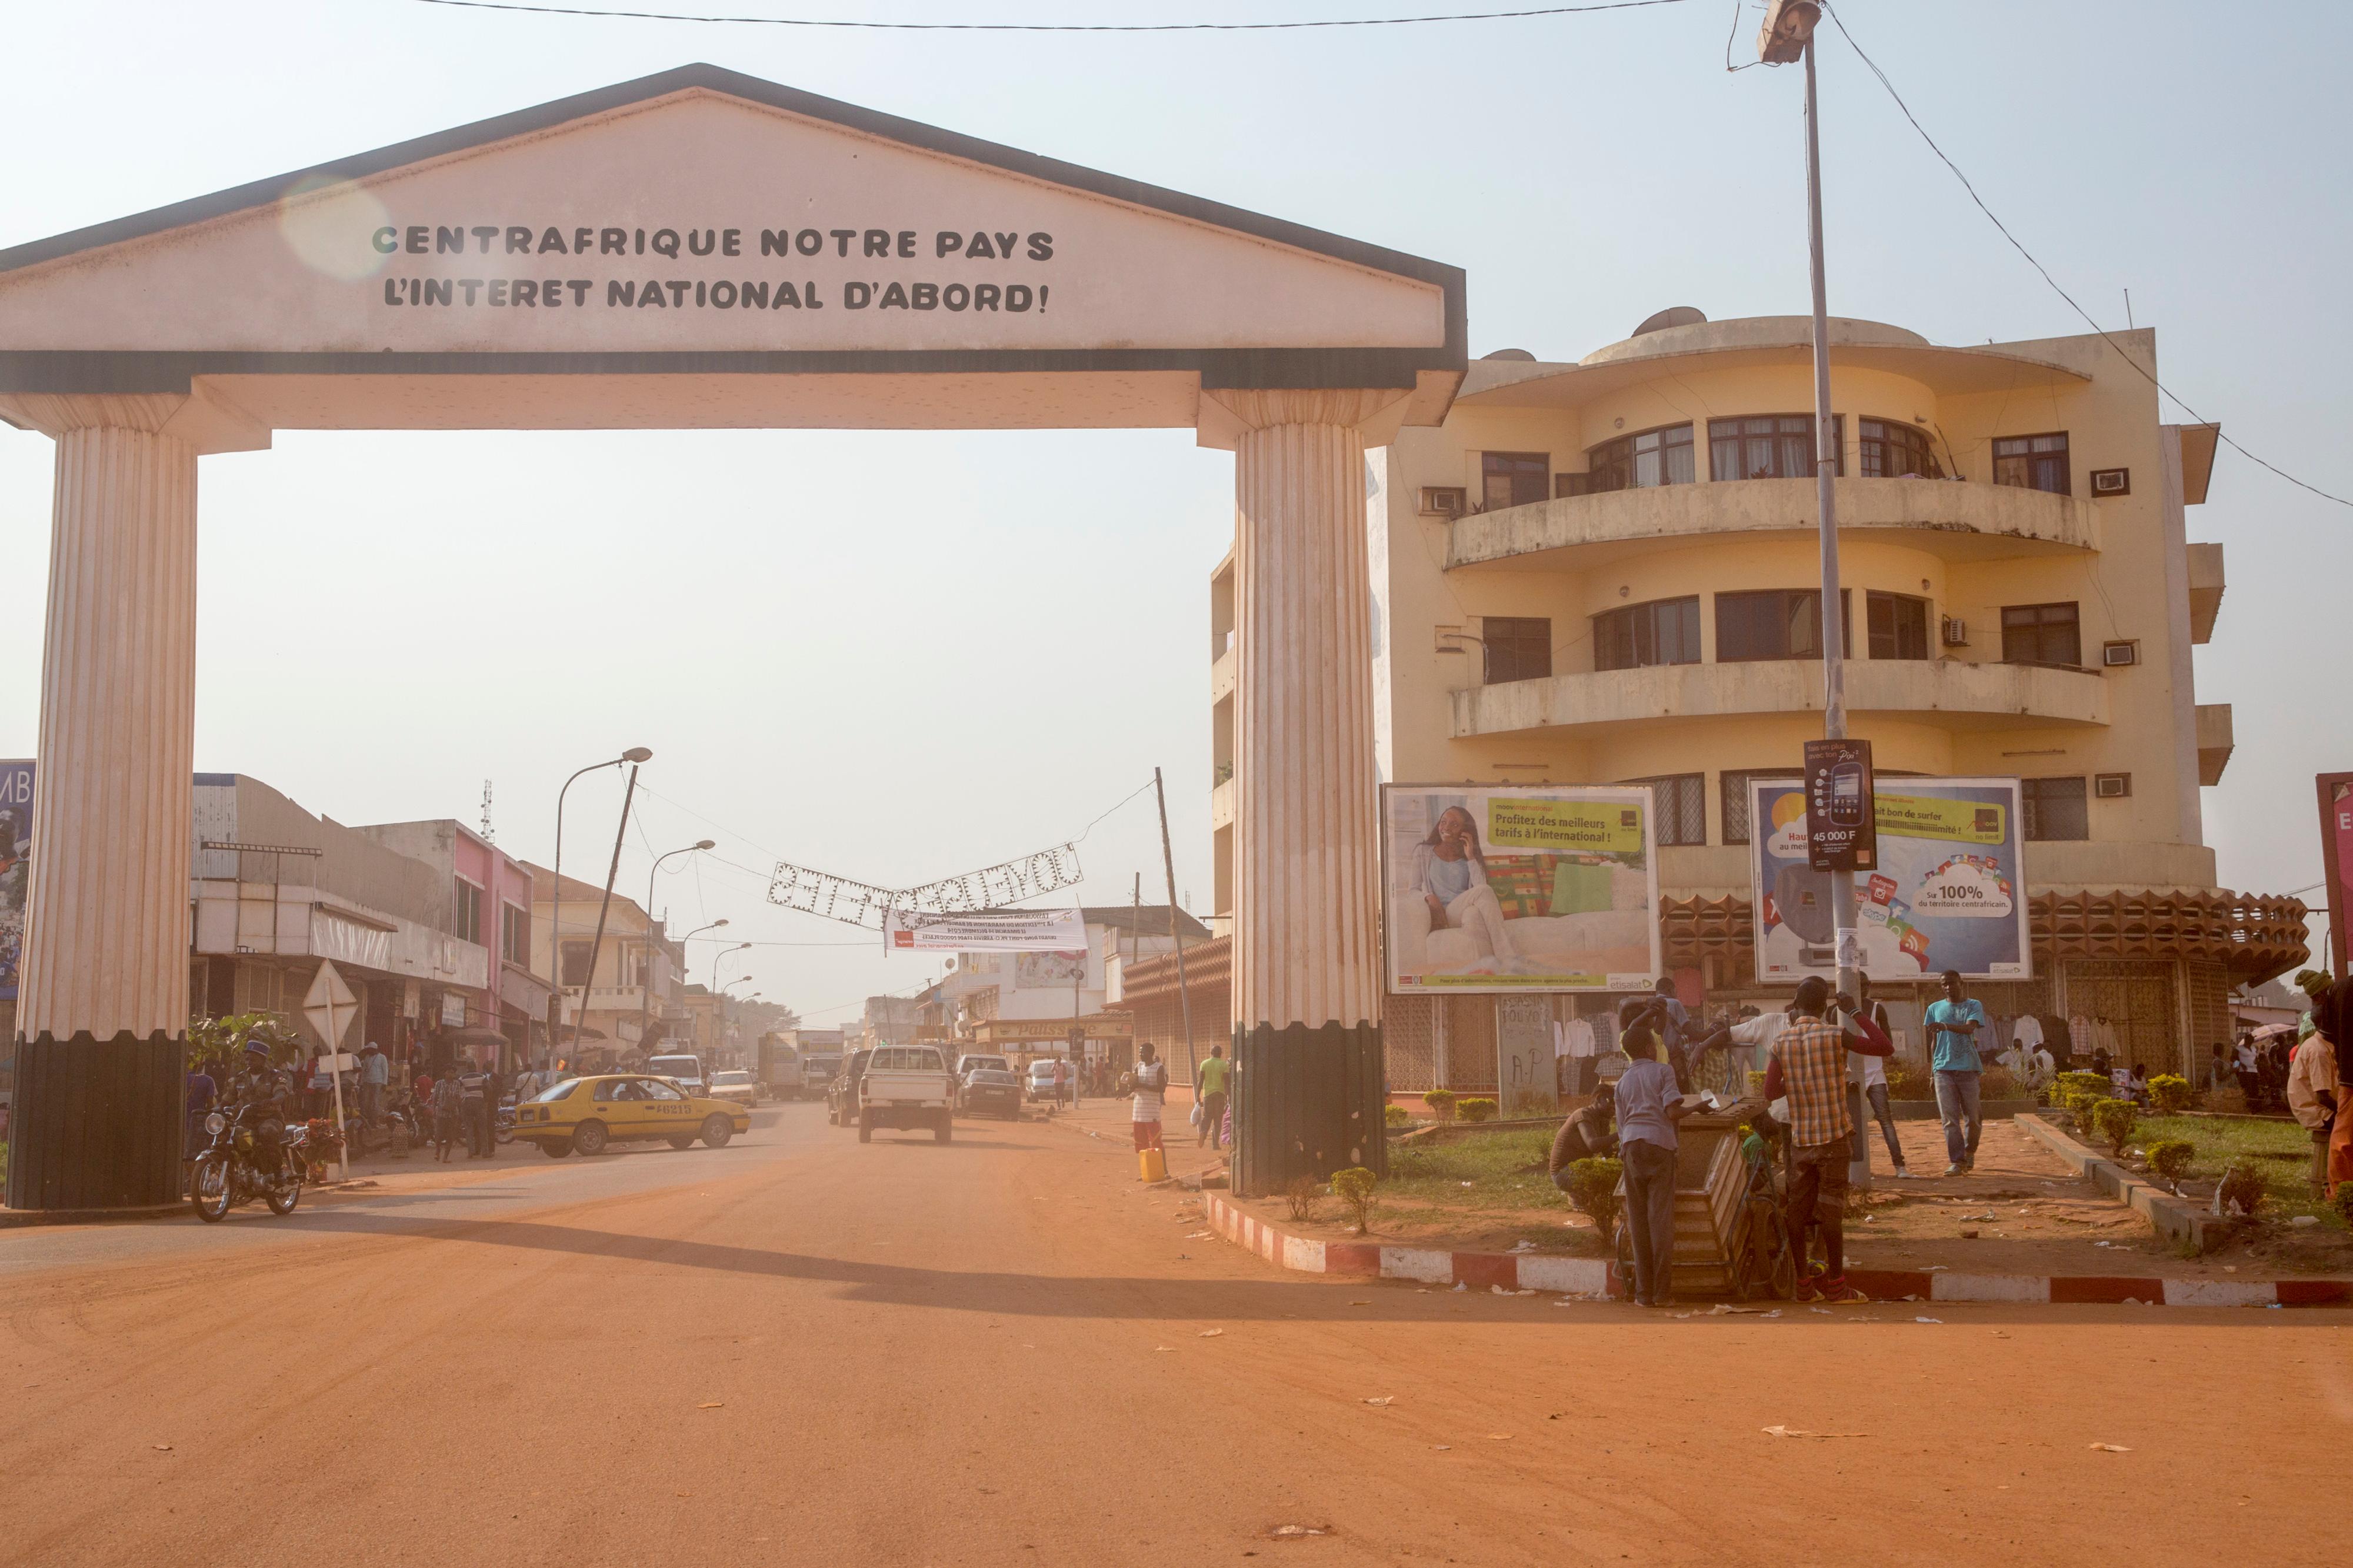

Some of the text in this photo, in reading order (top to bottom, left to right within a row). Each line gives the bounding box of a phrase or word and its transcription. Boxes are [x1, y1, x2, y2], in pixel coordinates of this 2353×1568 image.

[372, 226, 1054, 262] CENTRAFRIQUE NOTRE PAYS
[384, 278, 1049, 313] L'INTERET NATIONAL D'ABORD!
[1831, 743, 1846, 751] plus
[1495, 814, 1605, 829] Profitez des meilleurs
[1887, 808, 1902, 817] bon
[1905, 809, 1916, 818] de
[1918, 811, 1941, 821] surfer
[2339, 813, 2353, 830] E
[1495, 828, 1611, 843] tarifs à l'international !
[1814, 830, 1856, 842] 45 000 F
[1939, 886, 1983, 899] 100%
[1611, 980, 1642, 989] etisalat
